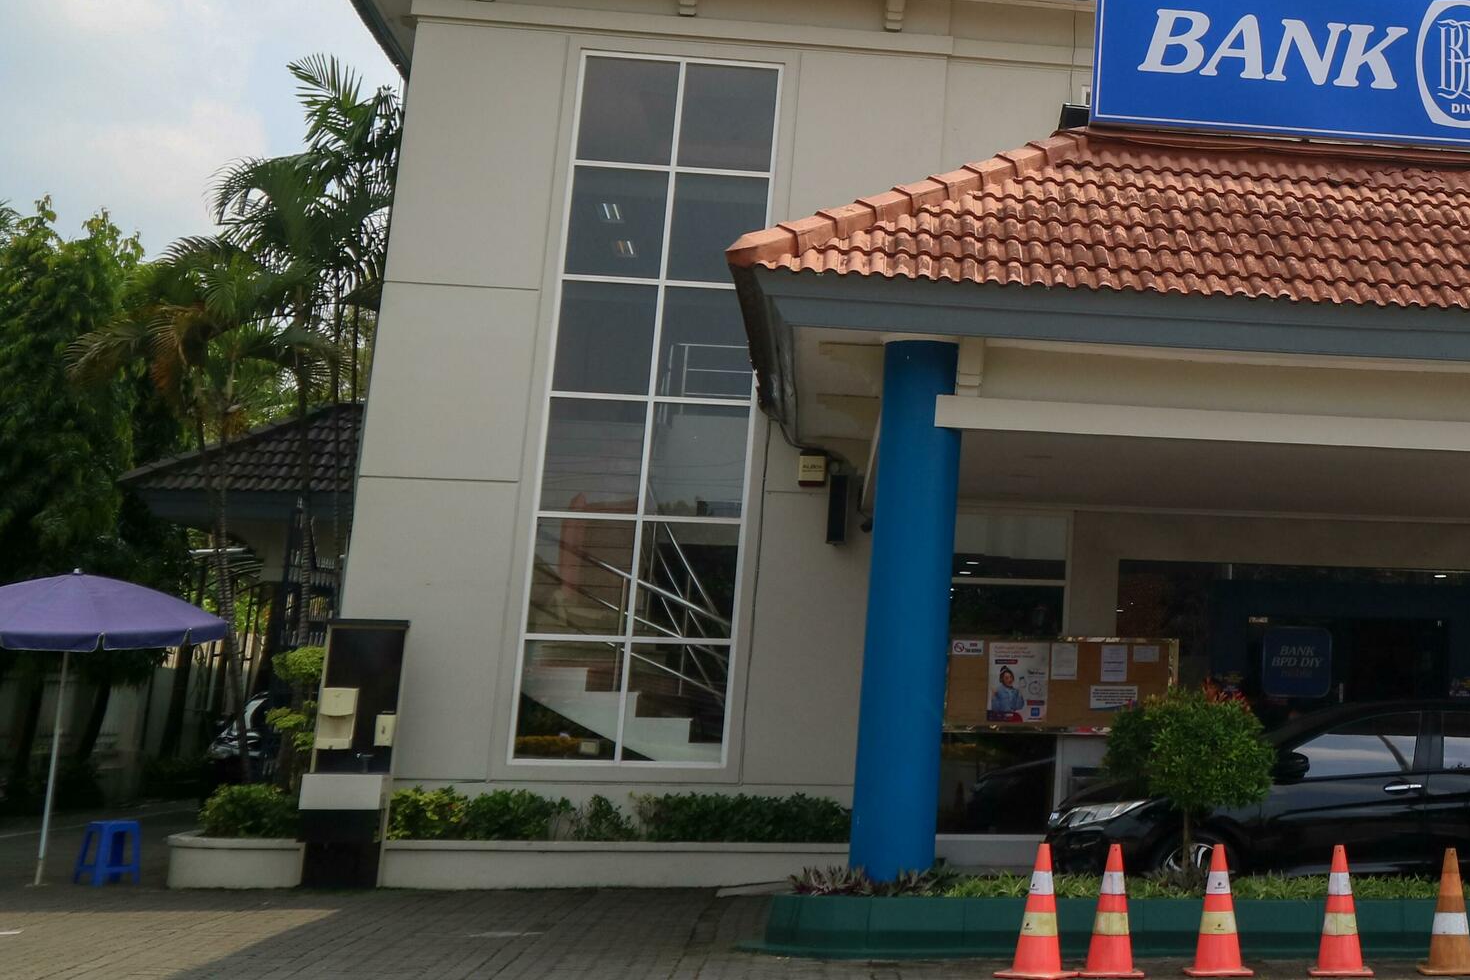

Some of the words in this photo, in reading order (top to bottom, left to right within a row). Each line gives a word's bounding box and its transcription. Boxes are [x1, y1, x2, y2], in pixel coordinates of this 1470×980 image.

[1137, 8, 1409, 90] BANK
[1280, 644, 1315, 657] BANK
[1300, 656, 1322, 668] DIY
